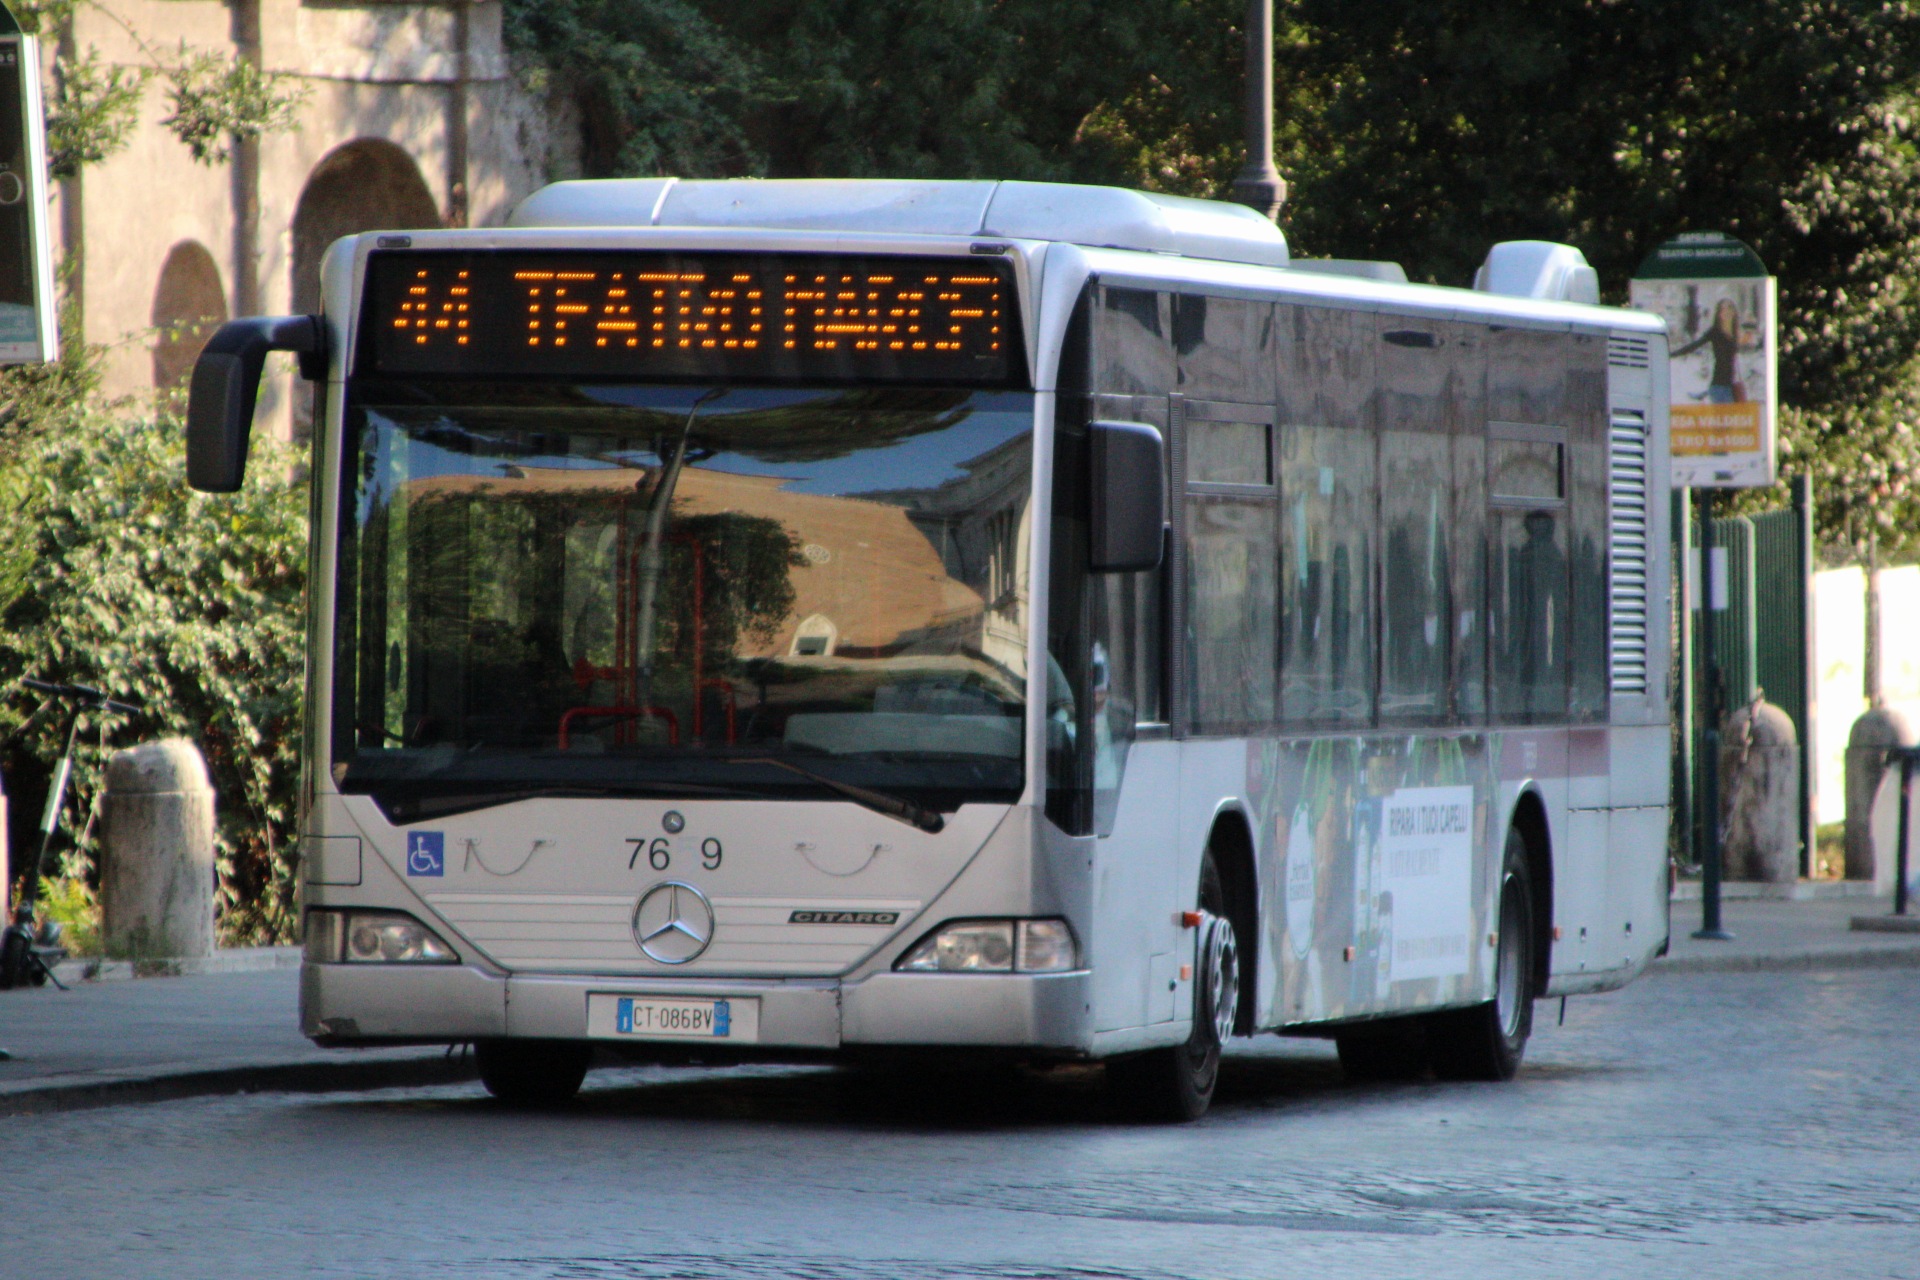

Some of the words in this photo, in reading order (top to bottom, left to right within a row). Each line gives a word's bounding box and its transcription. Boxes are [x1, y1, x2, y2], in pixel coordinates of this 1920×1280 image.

[393, 270, 470, 346] 44
[1389, 806, 1416, 836] RIPARA
[1421, 805, 1439, 835] TUOI
[1440, 803, 1468, 834] CAPELLI
[794, 912, 895, 924] CITARO
